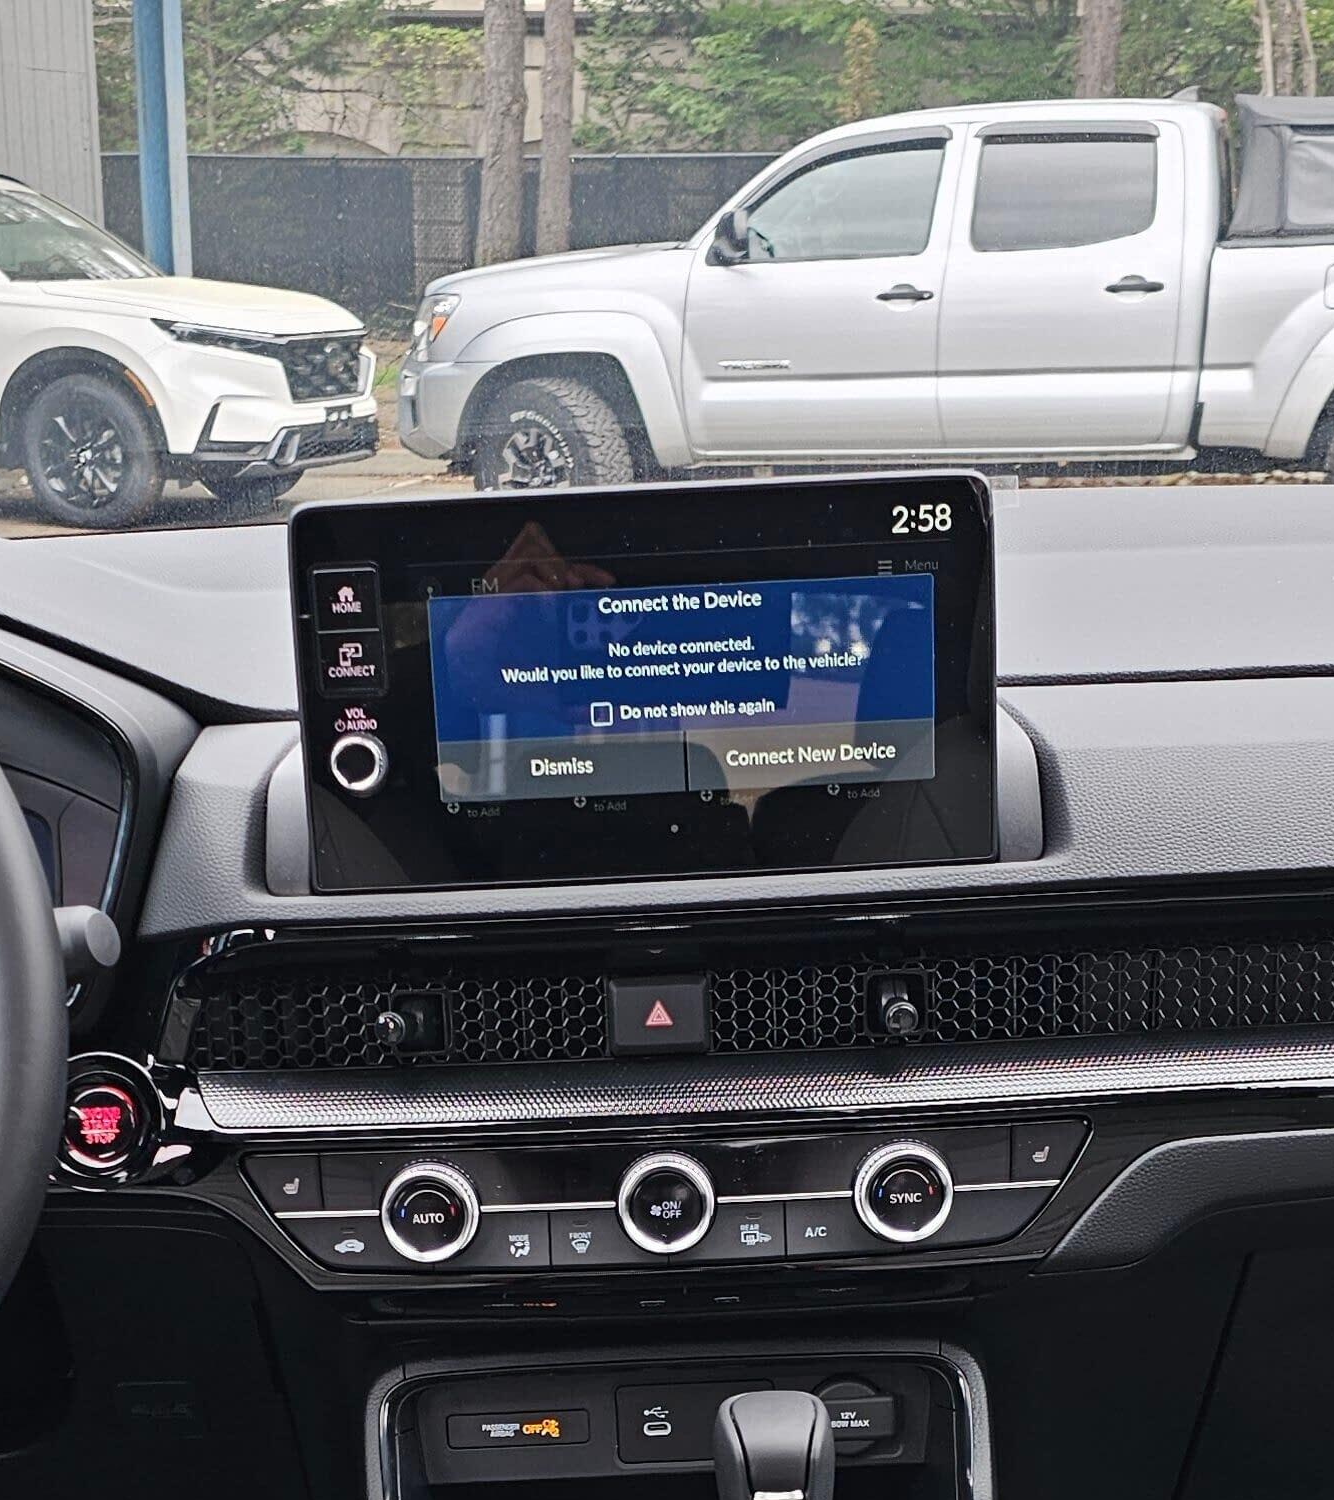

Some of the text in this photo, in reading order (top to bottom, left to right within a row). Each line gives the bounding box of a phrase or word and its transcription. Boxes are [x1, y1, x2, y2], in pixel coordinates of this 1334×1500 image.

[891, 503, 952, 534] 2:58
[905, 560, 939, 571] Menu
[471, 578, 499, 595] FM
[331, 602, 362, 613] HOME
[598, 590, 762, 614] Connect the Device
[608, 636, 755, 657] No device connected.
[328, 665, 376, 678] CONNECT
[501, 653, 865, 683] Would you like to connect your device to the vehicle?
[345, 707, 366, 720] VOL
[620, 698, 775, 720] Do not show this again
[346, 719, 377, 731] AUDIO
[726, 742, 896, 767] Connect New Device
[530, 757, 594, 777] Dismiss
[85, 1133, 116, 1144] STOP
[889, 1192, 922, 1204] SYNC
[662, 1201, 681, 1211] ON/
[412, 1213, 444, 1224] AUTO
[662, 1210, 682, 1219] OFF
[508, 1234, 529, 1242] MODE
[569, 1232, 592, 1240] FRONT
[805, 1226, 827, 1238] A/C
[840, 1411, 857, 1420] 12V
[522, 1424, 543, 1435] OFF
[850, 1419, 870, 1428] MAX
